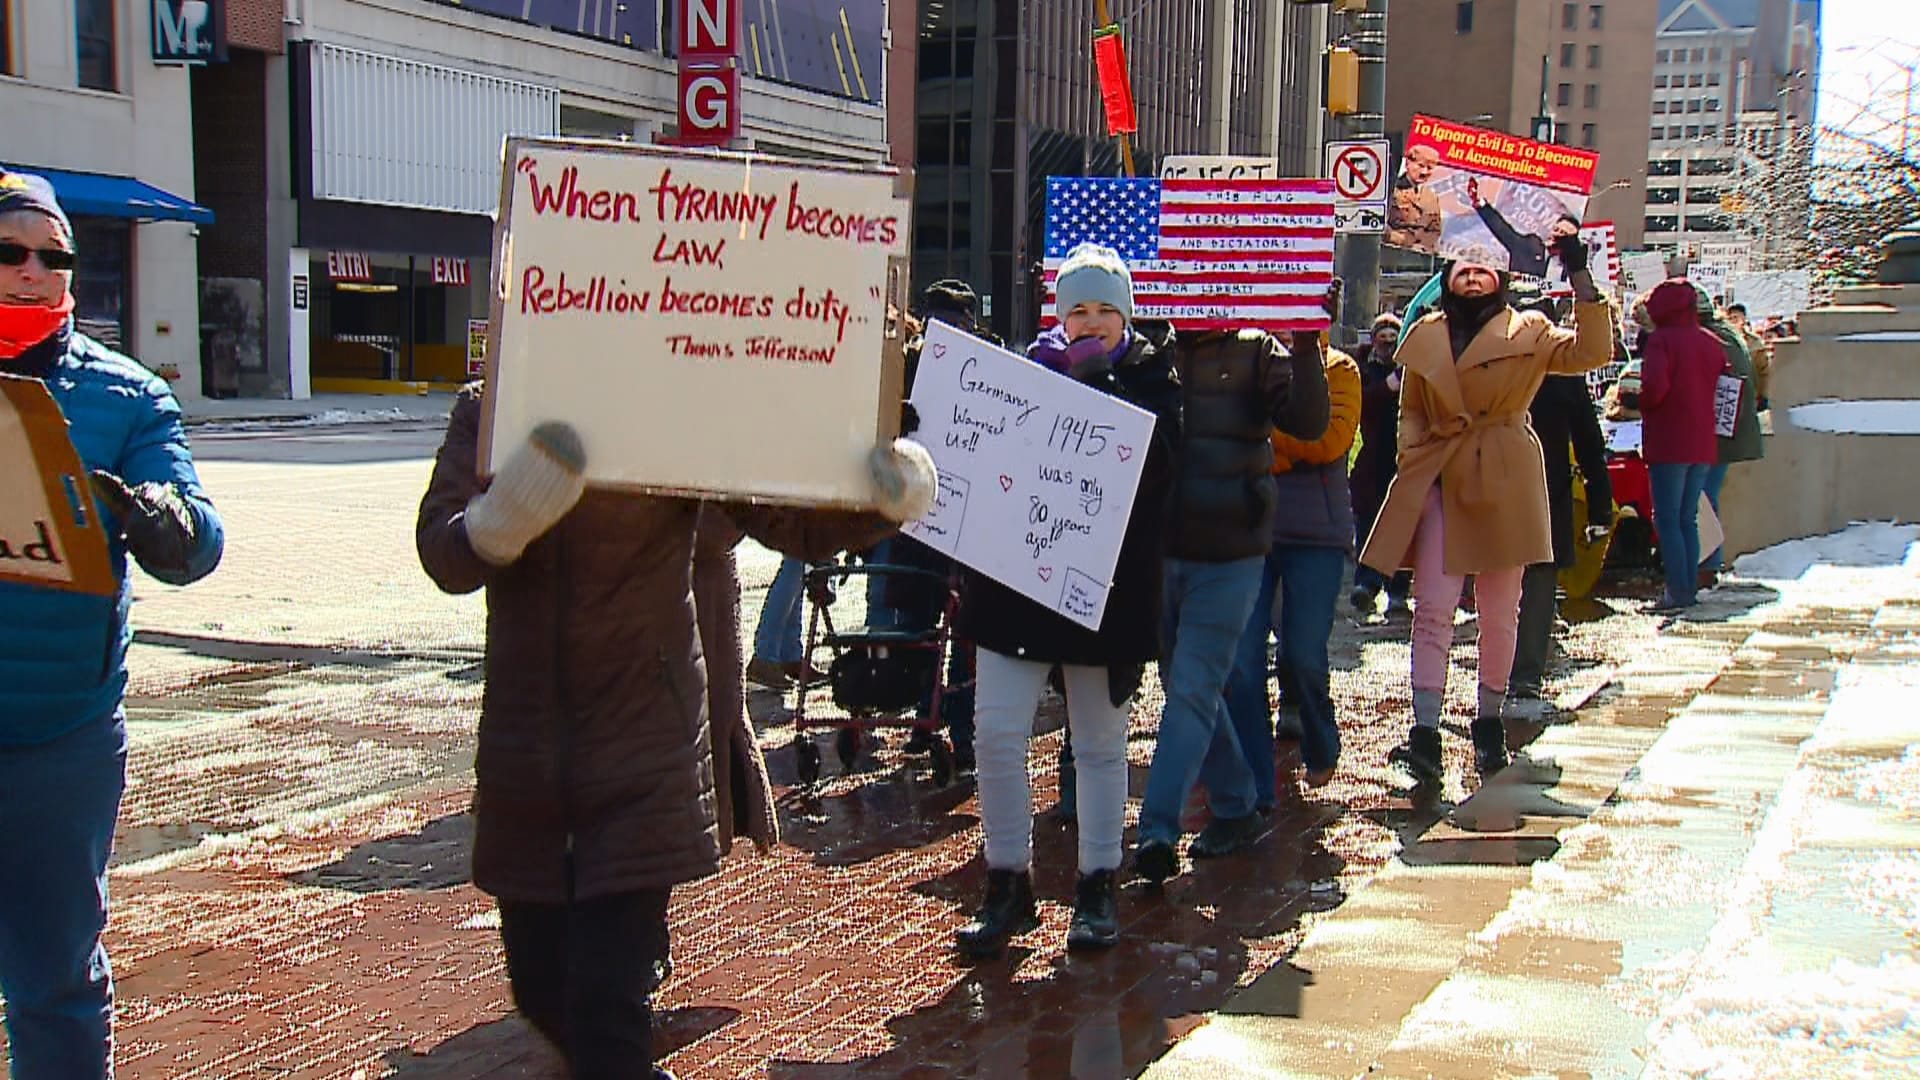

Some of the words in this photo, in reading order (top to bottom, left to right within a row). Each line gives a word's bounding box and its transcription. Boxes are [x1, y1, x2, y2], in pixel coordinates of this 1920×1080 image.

[1414, 119, 1431, 135] To
[1432, 123, 1476, 145] Ignore
[1477, 134, 1501, 150] Evil
[1501, 142, 1516, 154] Is
[1518, 142, 1535, 159] To
[1536, 146, 1593, 170] Become
[1447, 145, 1465, 162] An
[1253, 191, 1294, 202] FLAG
[1180, 239, 1202, 249] AND
[328, 251, 370, 279] ENTRY
[434, 257, 467, 284] EXIT
[521, 266, 651, 315] Rebellion
[960, 357, 1040, 426] Germany
[1047, 413, 1116, 457] 1945
